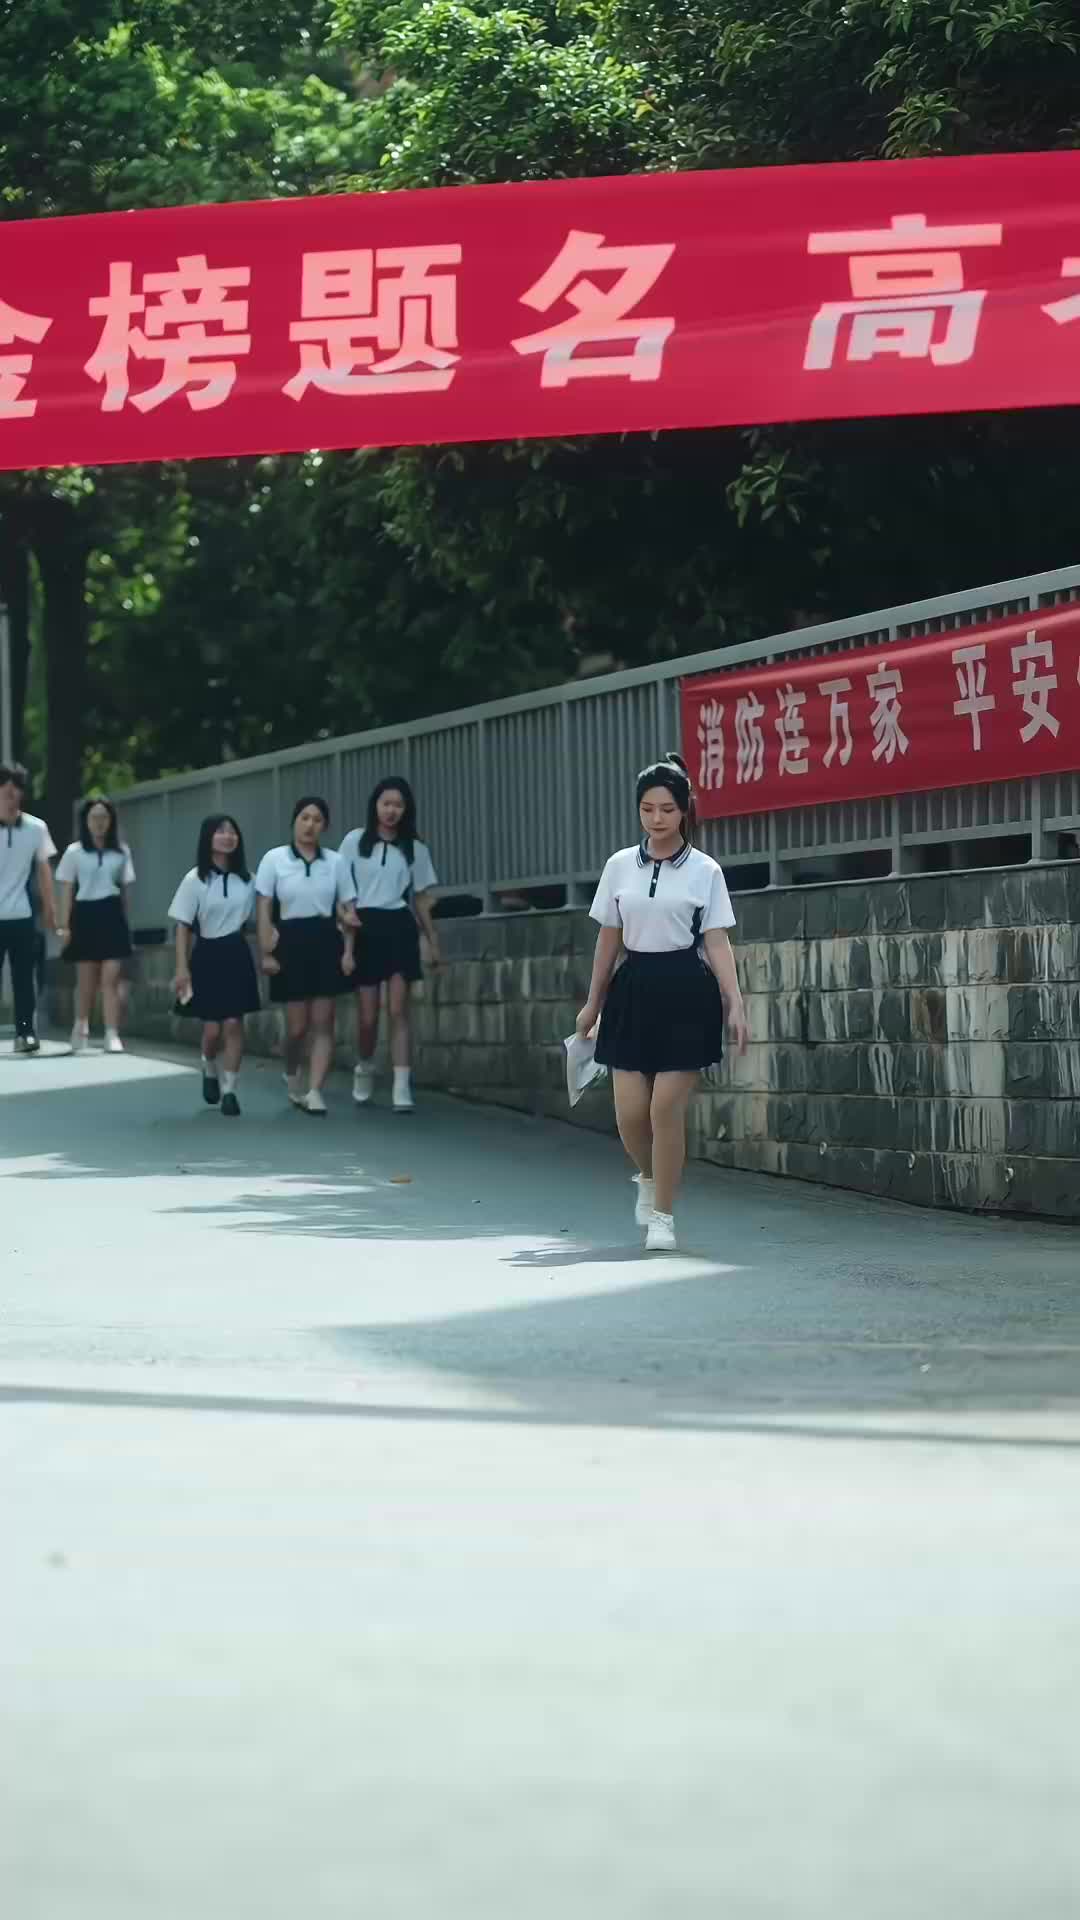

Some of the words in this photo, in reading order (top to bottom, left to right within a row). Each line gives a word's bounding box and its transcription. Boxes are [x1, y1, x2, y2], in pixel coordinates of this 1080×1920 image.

[803, 213, 1080, 370] 高
[696, 661, 909, 790] 消防连万家
[951, 630, 1080, 752] 平安
